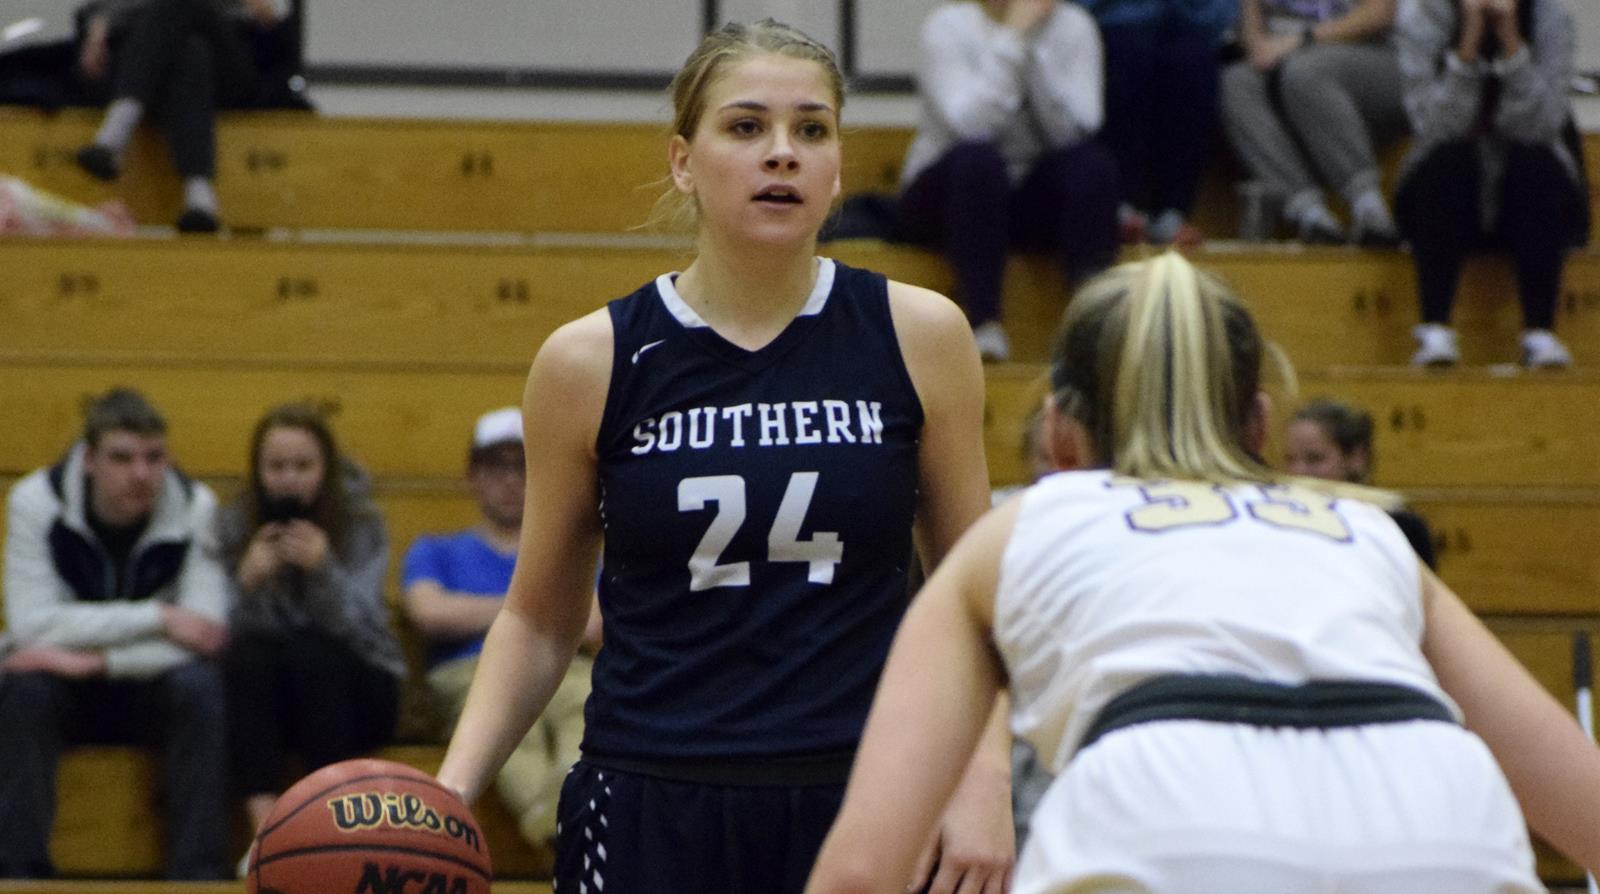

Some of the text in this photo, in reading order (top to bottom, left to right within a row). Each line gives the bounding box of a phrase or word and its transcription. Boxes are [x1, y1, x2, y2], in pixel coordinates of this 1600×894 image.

[631, 399, 883, 456] SOUTHERN
[677, 471, 844, 592] 24
[327, 791, 481, 855] Wilson
